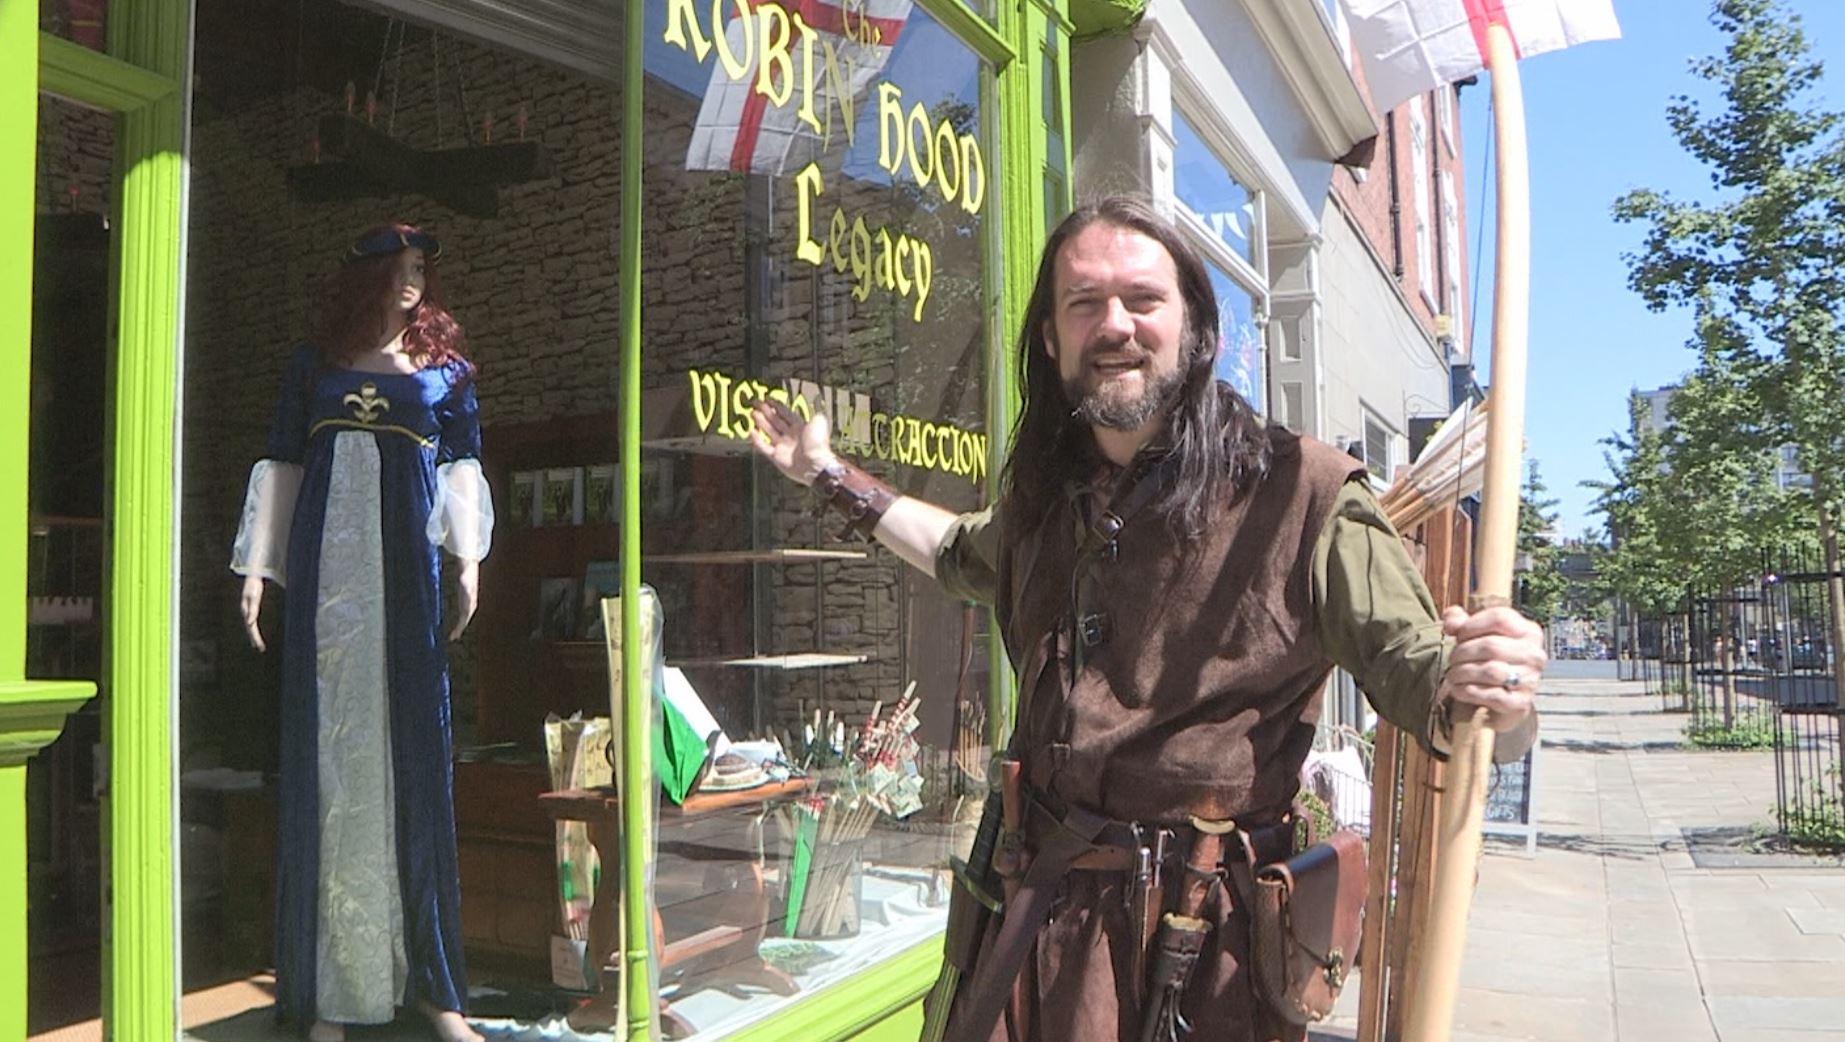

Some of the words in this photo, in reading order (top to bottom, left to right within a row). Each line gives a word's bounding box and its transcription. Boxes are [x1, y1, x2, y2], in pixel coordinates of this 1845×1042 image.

[796, 163, 933, 322] Legacy
[688, 369, 824, 446] VISI
[838, 404, 987, 485] ATTRACTION
